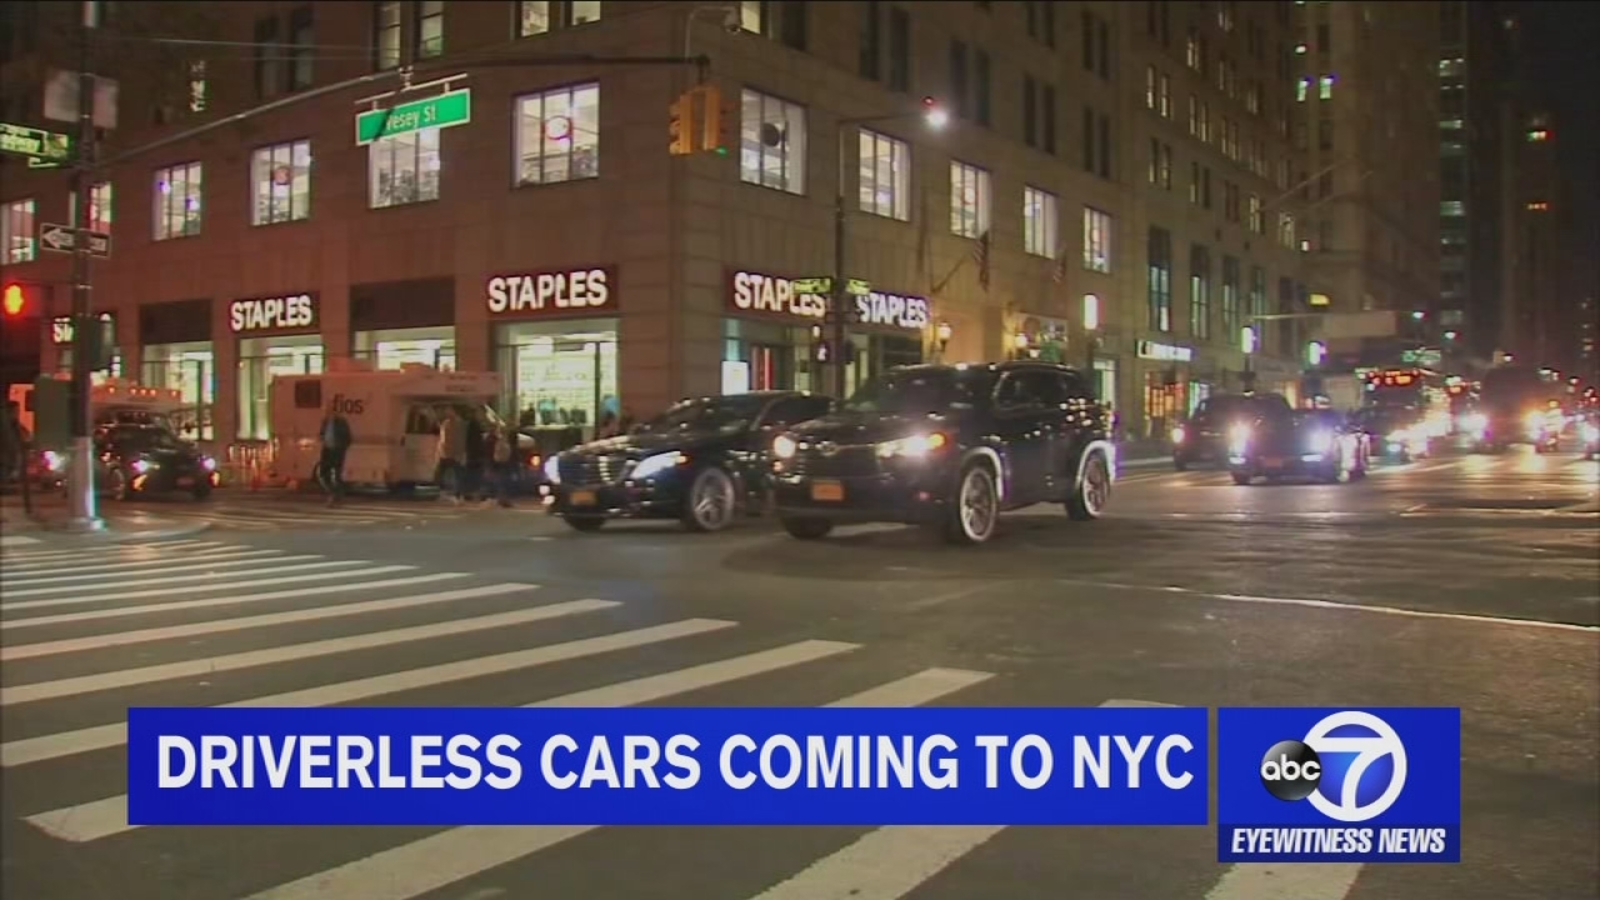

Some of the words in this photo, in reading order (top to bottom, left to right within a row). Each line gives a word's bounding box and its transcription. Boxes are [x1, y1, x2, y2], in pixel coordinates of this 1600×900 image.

[424, 103, 436, 122] St
[488, 269, 608, 312] STAPLES
[734, 272, 826, 318] STAPLES
[230, 295, 312, 331] STAPLES
[856, 292, 927, 329] STAPLES
